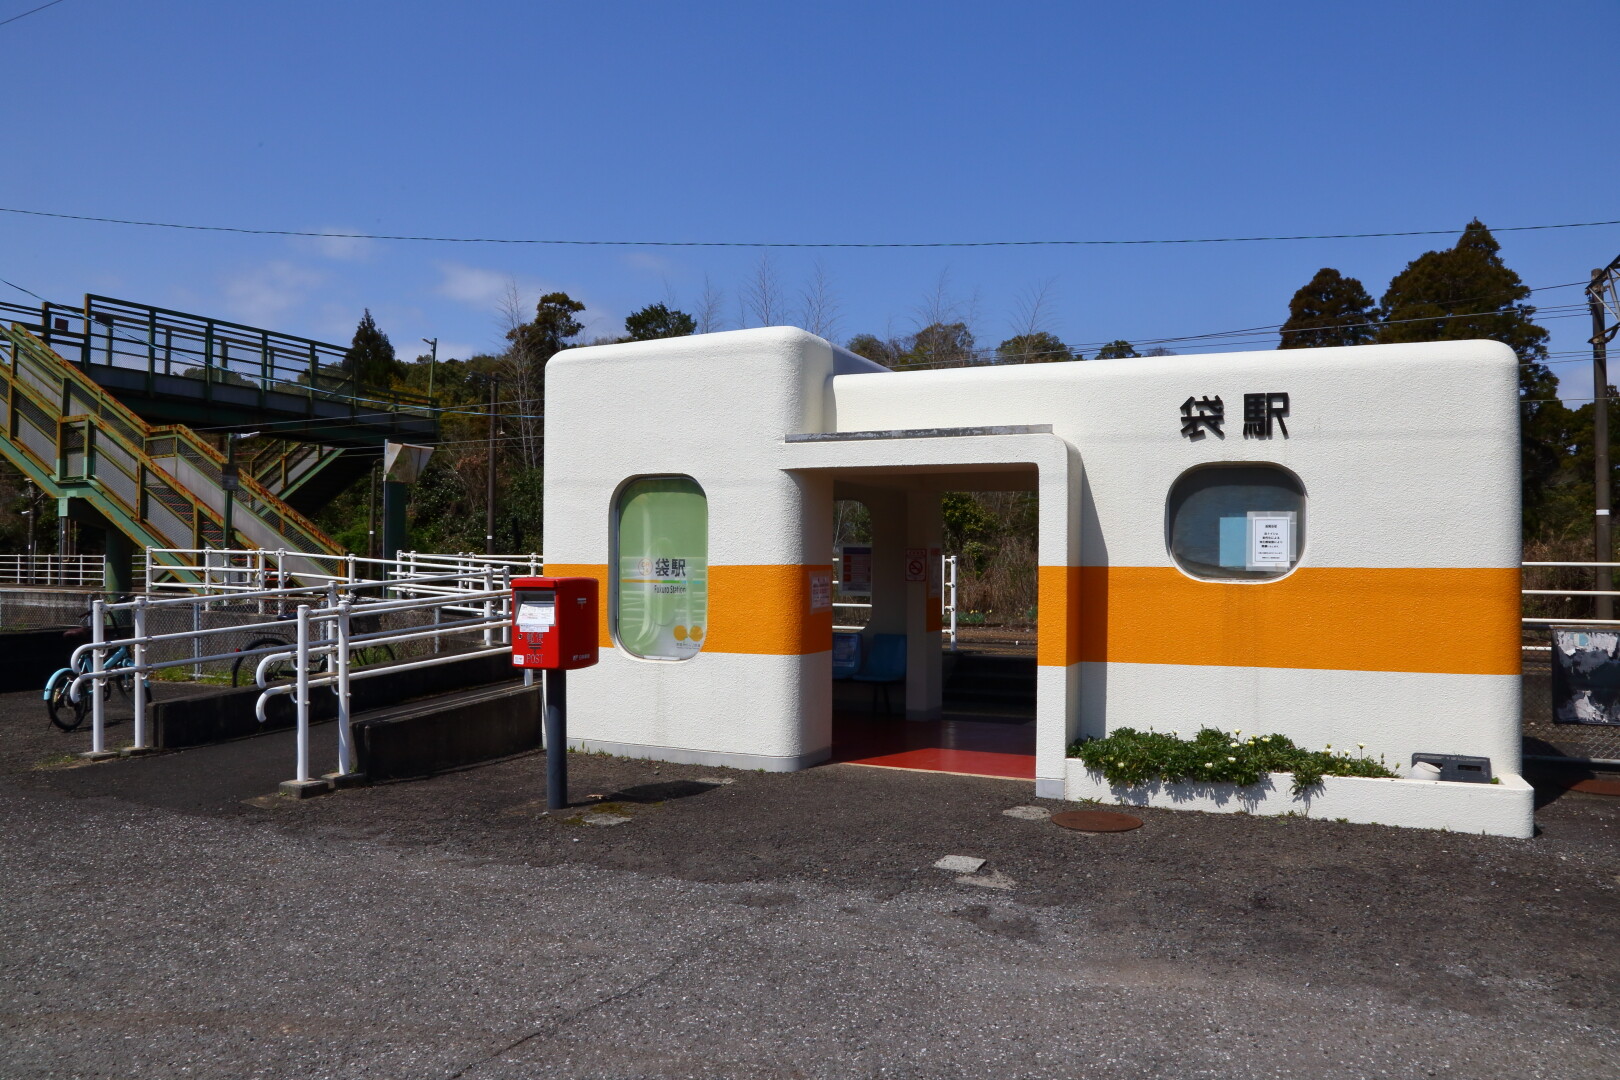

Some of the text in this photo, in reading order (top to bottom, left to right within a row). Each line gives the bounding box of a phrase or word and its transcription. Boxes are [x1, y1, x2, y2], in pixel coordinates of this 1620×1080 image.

[1180, 392, 1289, 438] 袋駅
[655, 557, 686, 577] 袋駅
[526, 653, 544, 664] POST
